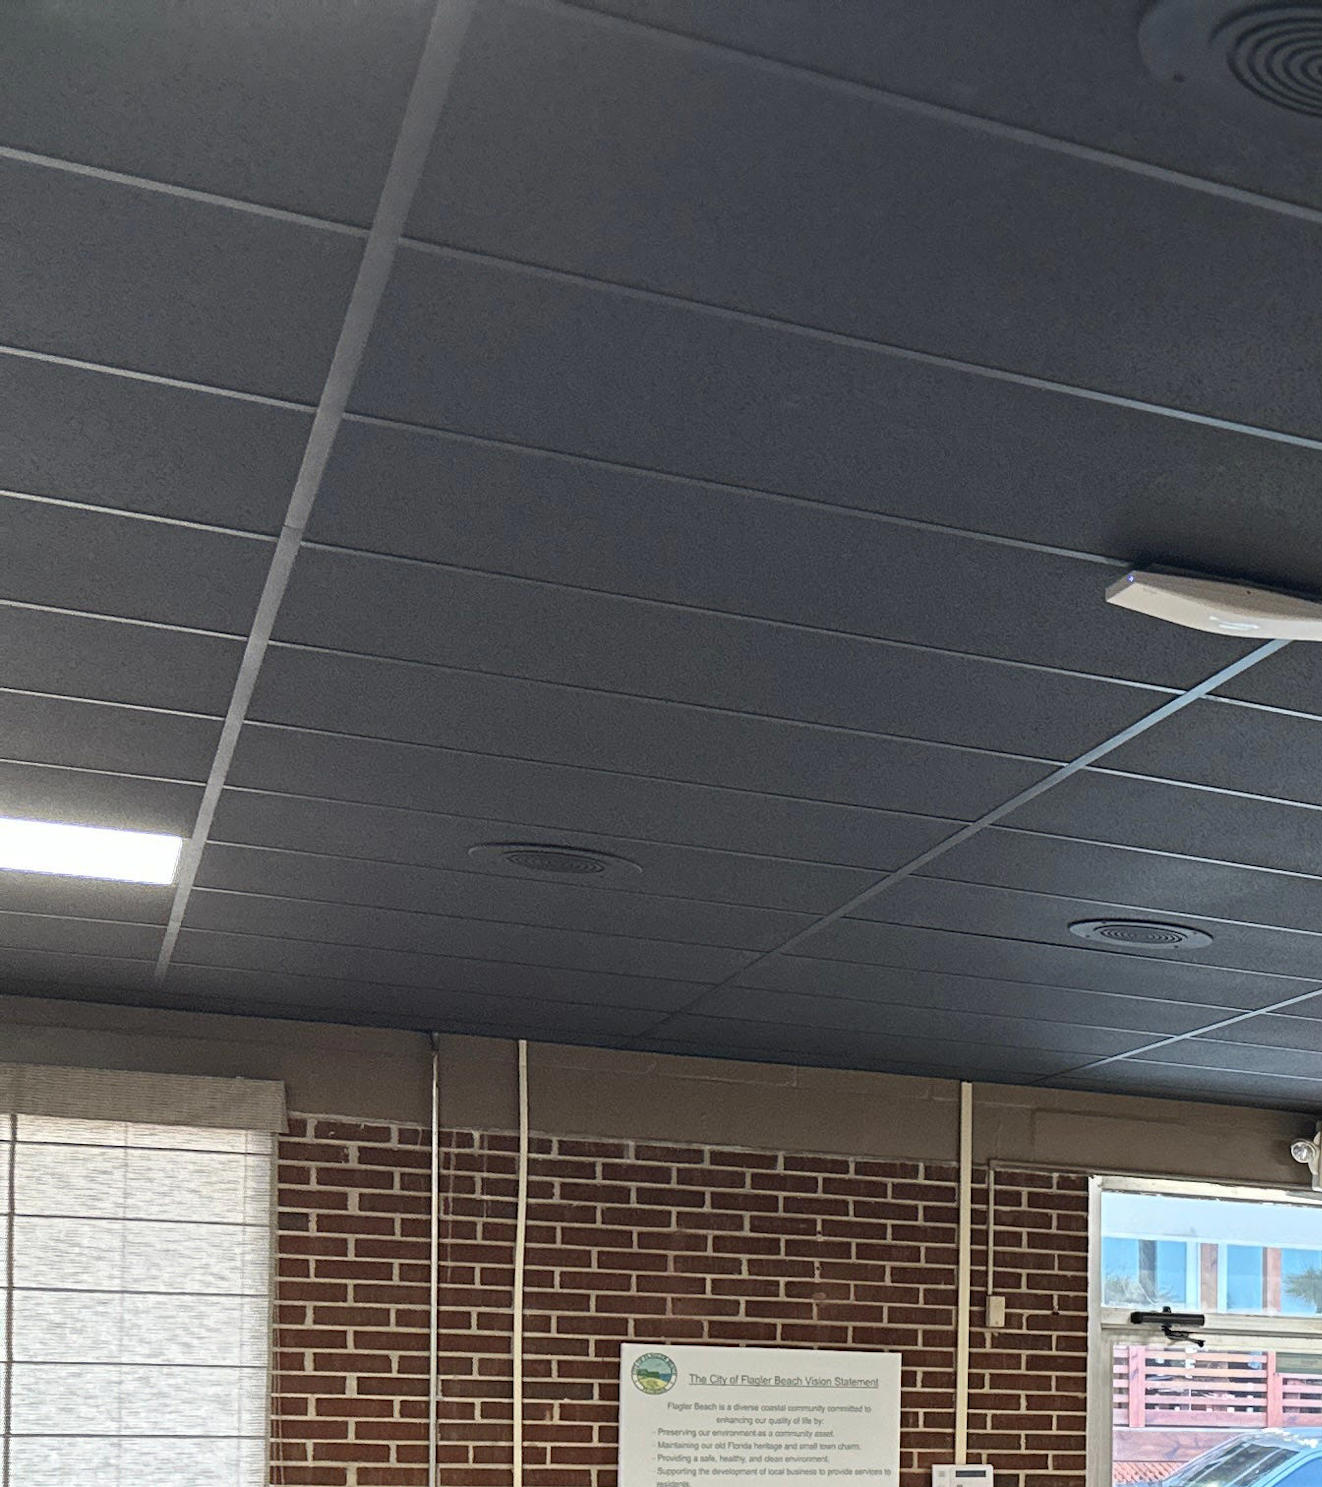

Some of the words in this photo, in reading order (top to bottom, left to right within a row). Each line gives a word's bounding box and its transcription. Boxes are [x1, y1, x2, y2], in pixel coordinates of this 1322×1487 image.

[689, 1373, 706, 1384] The
[710, 1374, 726, 1386] City
[730, 1375, 739, 1384] of
[742, 1375, 772, 1387] Flagler
[774, 1376, 803, 1386] Beach
[805, 1377, 832, 1387] Vision
[834, 1377, 879, 1388] Statement
[667, 1402, 692, 1412] Flagler
[694, 1402, 717, 1411] Beach
[768, 1417, 792, 1427] quality
[658, 1428, 697, 1438] Preserving
[658, 1441, 700, 1451] Maintaining
[784, 1442, 798, 1450] and
[657, 1454, 692, 1464] Providing
[657, 1467, 697, 1477] Supporting
